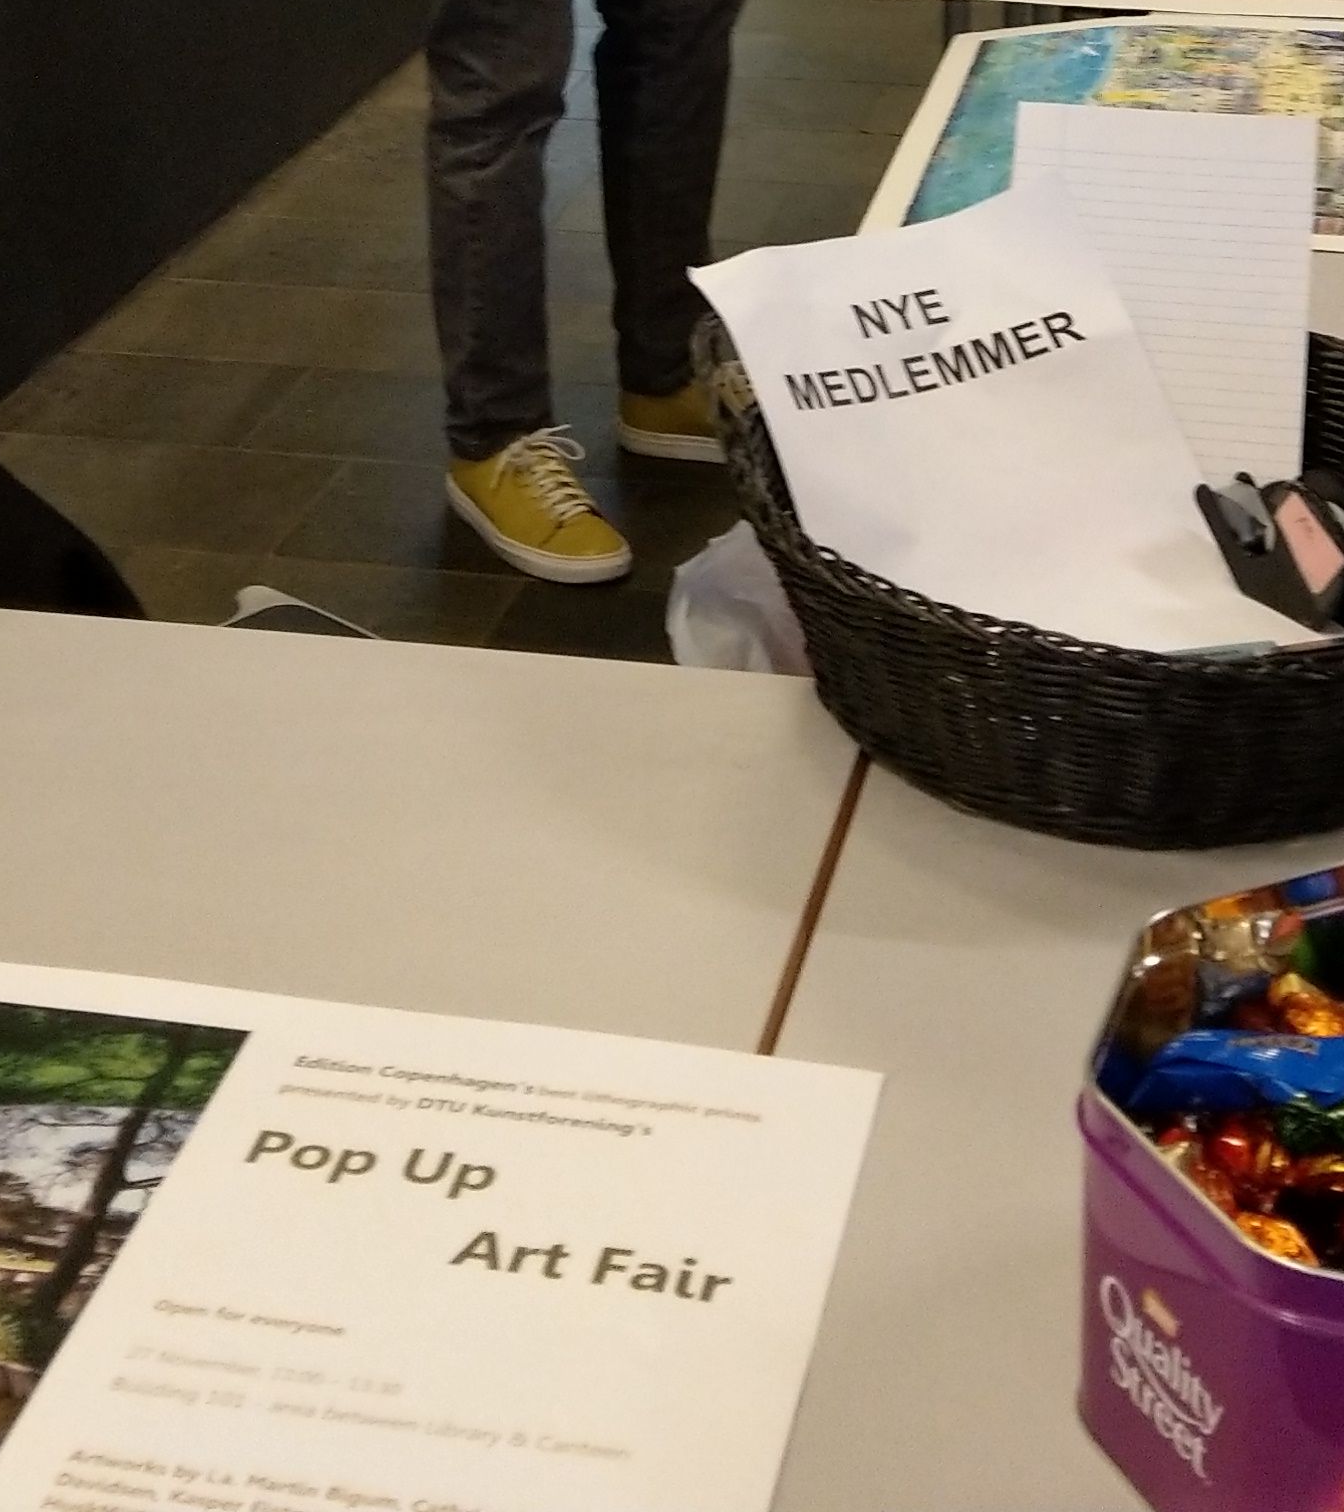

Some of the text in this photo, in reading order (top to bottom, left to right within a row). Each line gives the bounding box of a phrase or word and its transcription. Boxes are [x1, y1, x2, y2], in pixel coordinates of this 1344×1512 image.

[850, 289, 950, 339] NYE
[784, 311, 1086, 410] MEDLEMMER
[277, 1083, 383, 1104] presented
[385, 1093, 411, 1111] by
[415, 1097, 467, 1114] DTU
[293, 1054, 373, 1076] Edition
[244, 1129, 498, 1199] Pop Up
[449, 1229, 734, 1303] Art Fair
[153, 1298, 347, 1335] Open for everyone
[1099, 1275, 1225, 1436] Quality
[1109, 1336, 1213, 1486] Street
